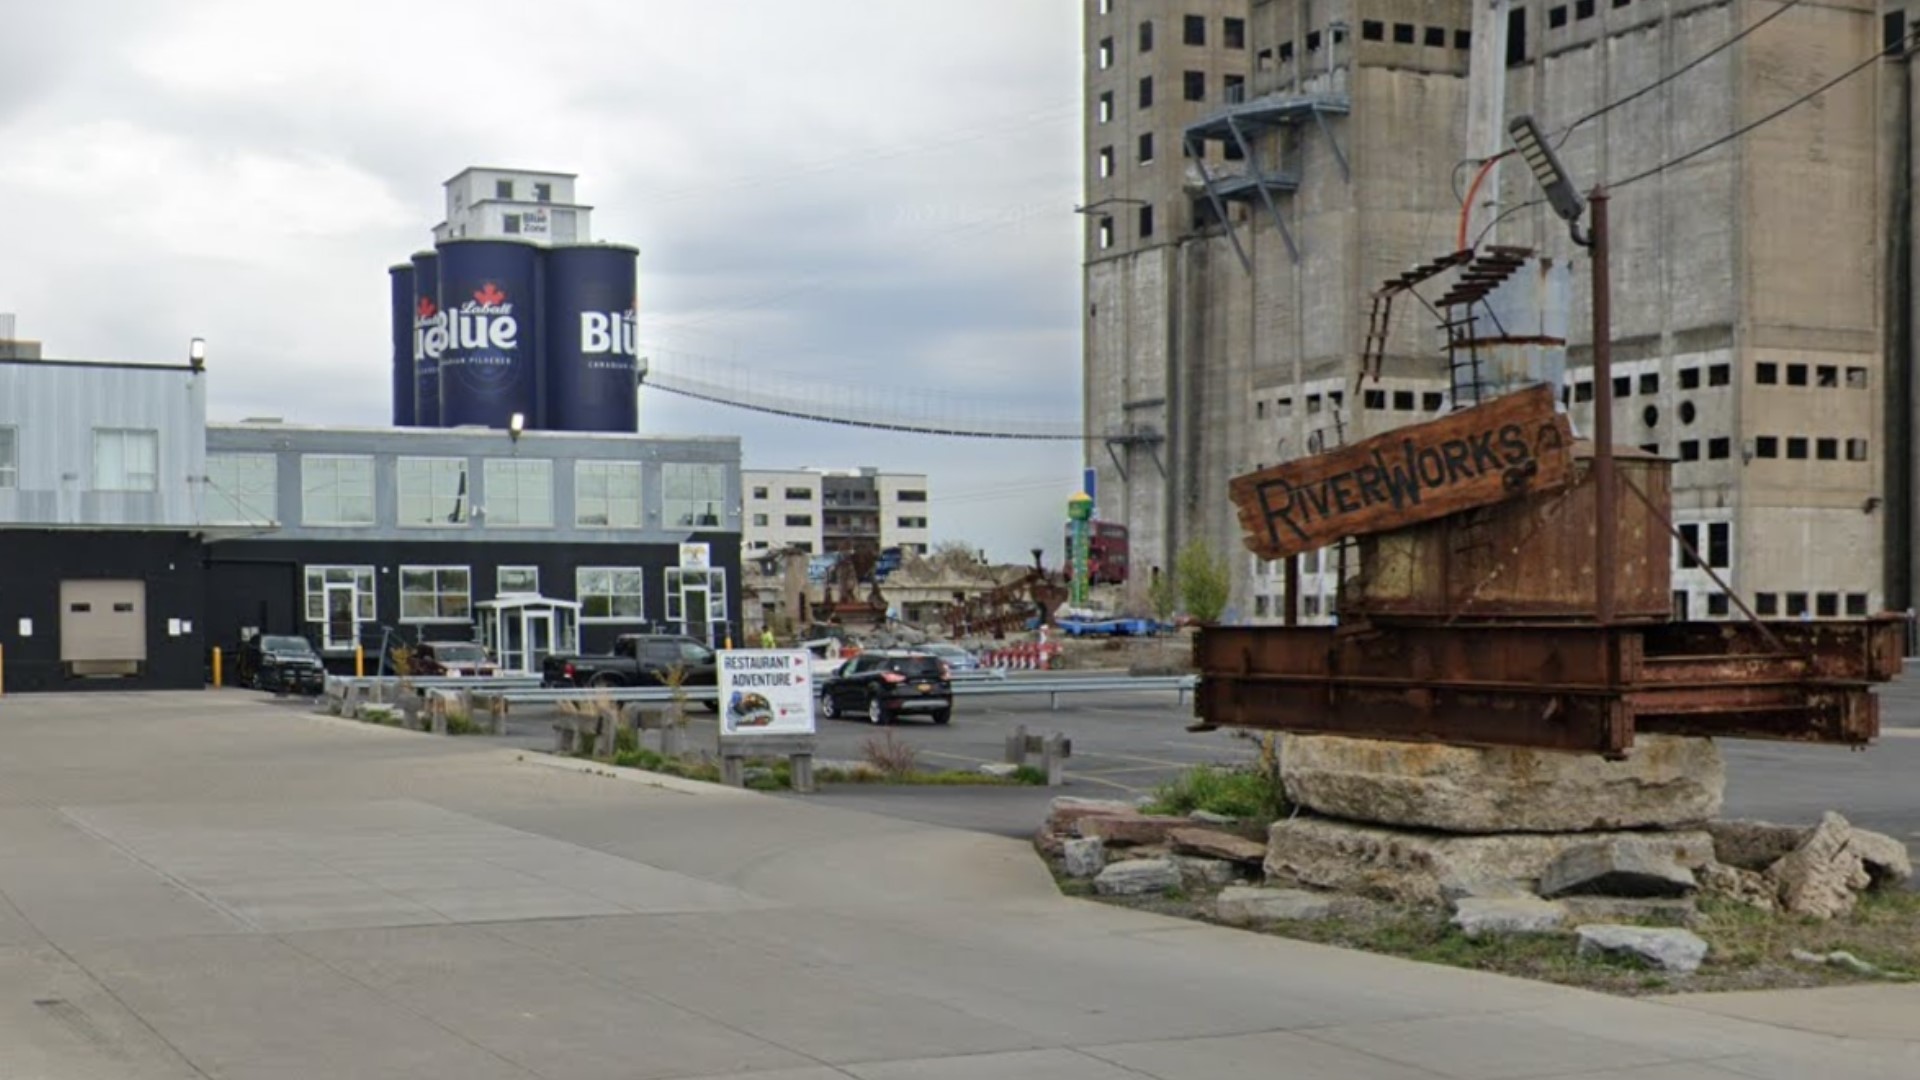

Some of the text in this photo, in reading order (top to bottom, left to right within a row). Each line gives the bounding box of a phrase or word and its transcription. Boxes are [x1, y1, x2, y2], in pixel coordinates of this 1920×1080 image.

[460, 300, 513, 314] Labatt
[724, 656, 791, 669] RESTAURANT
[732, 673, 792, 686] ADVENTURE
